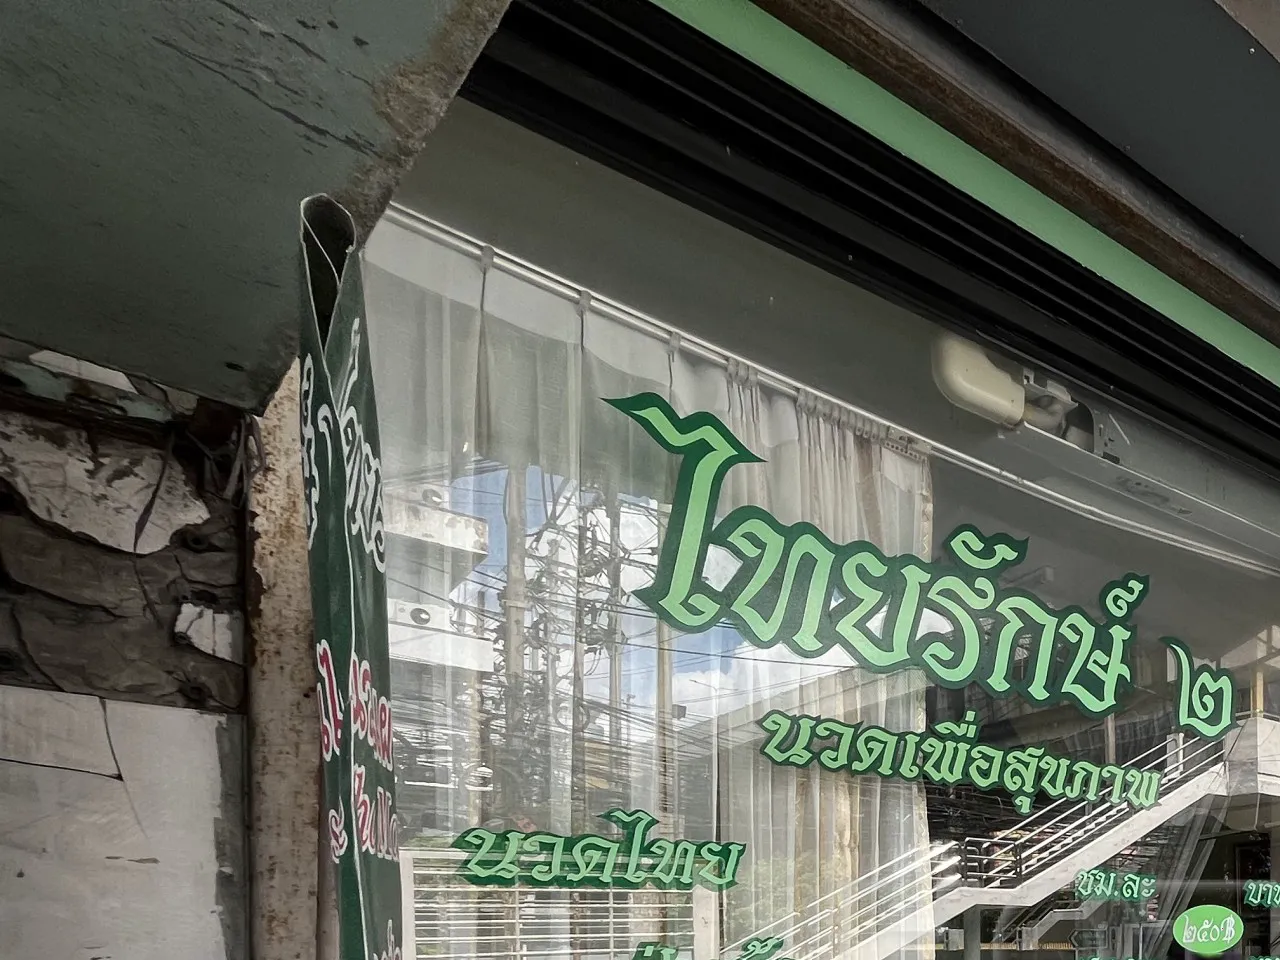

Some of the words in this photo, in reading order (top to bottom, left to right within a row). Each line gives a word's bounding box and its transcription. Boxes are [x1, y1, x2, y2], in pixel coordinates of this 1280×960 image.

[610, 397, 1148, 714] ไทยรักษ์
[1166, 640, 1235, 737] ๒
[760, 712, 1161, 812] นวดเพื่อสุขภาพ
[459, 810, 744, 888] นวดไทย
